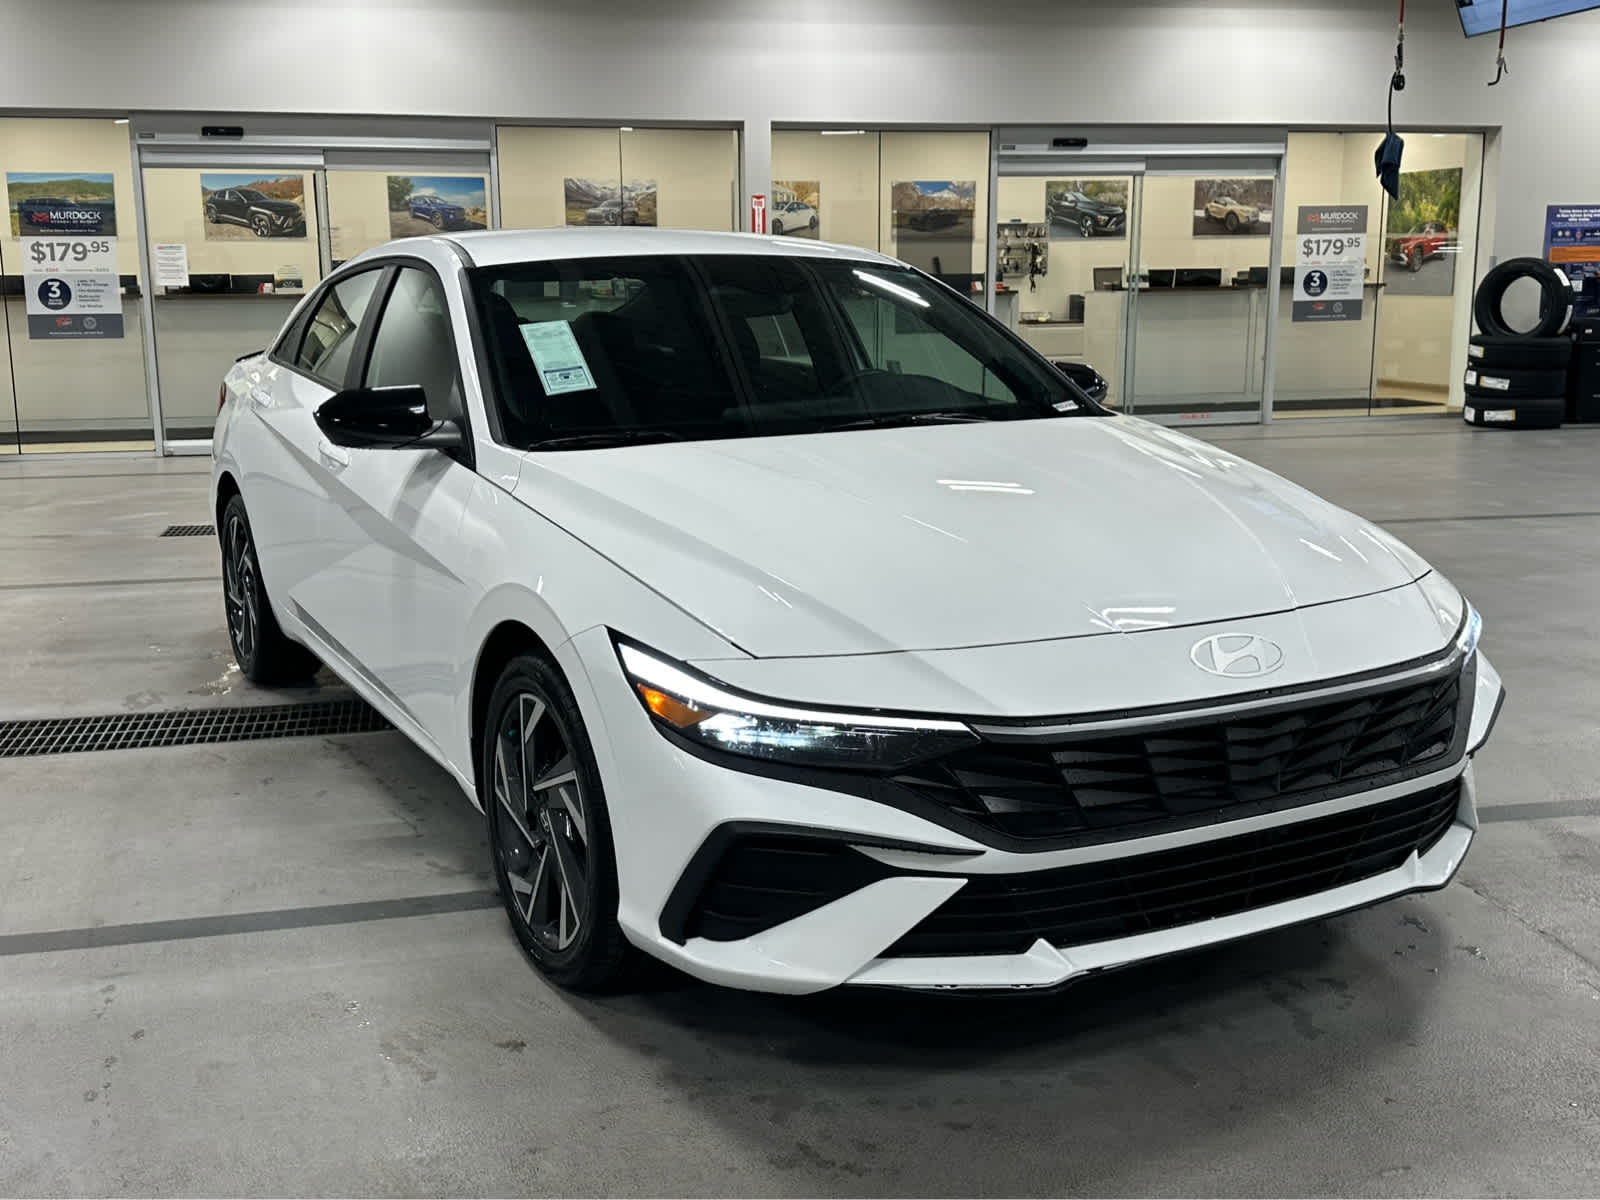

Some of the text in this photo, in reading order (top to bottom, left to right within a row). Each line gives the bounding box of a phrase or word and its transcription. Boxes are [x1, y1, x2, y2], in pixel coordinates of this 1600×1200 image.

[50, 211, 101, 220] MURDOCK
[30, 241, 110, 264] $179.95
[1302, 237, 1361, 258] $179.95
[1310, 272, 1321, 287] 3
[47, 281, 61, 298] 3
